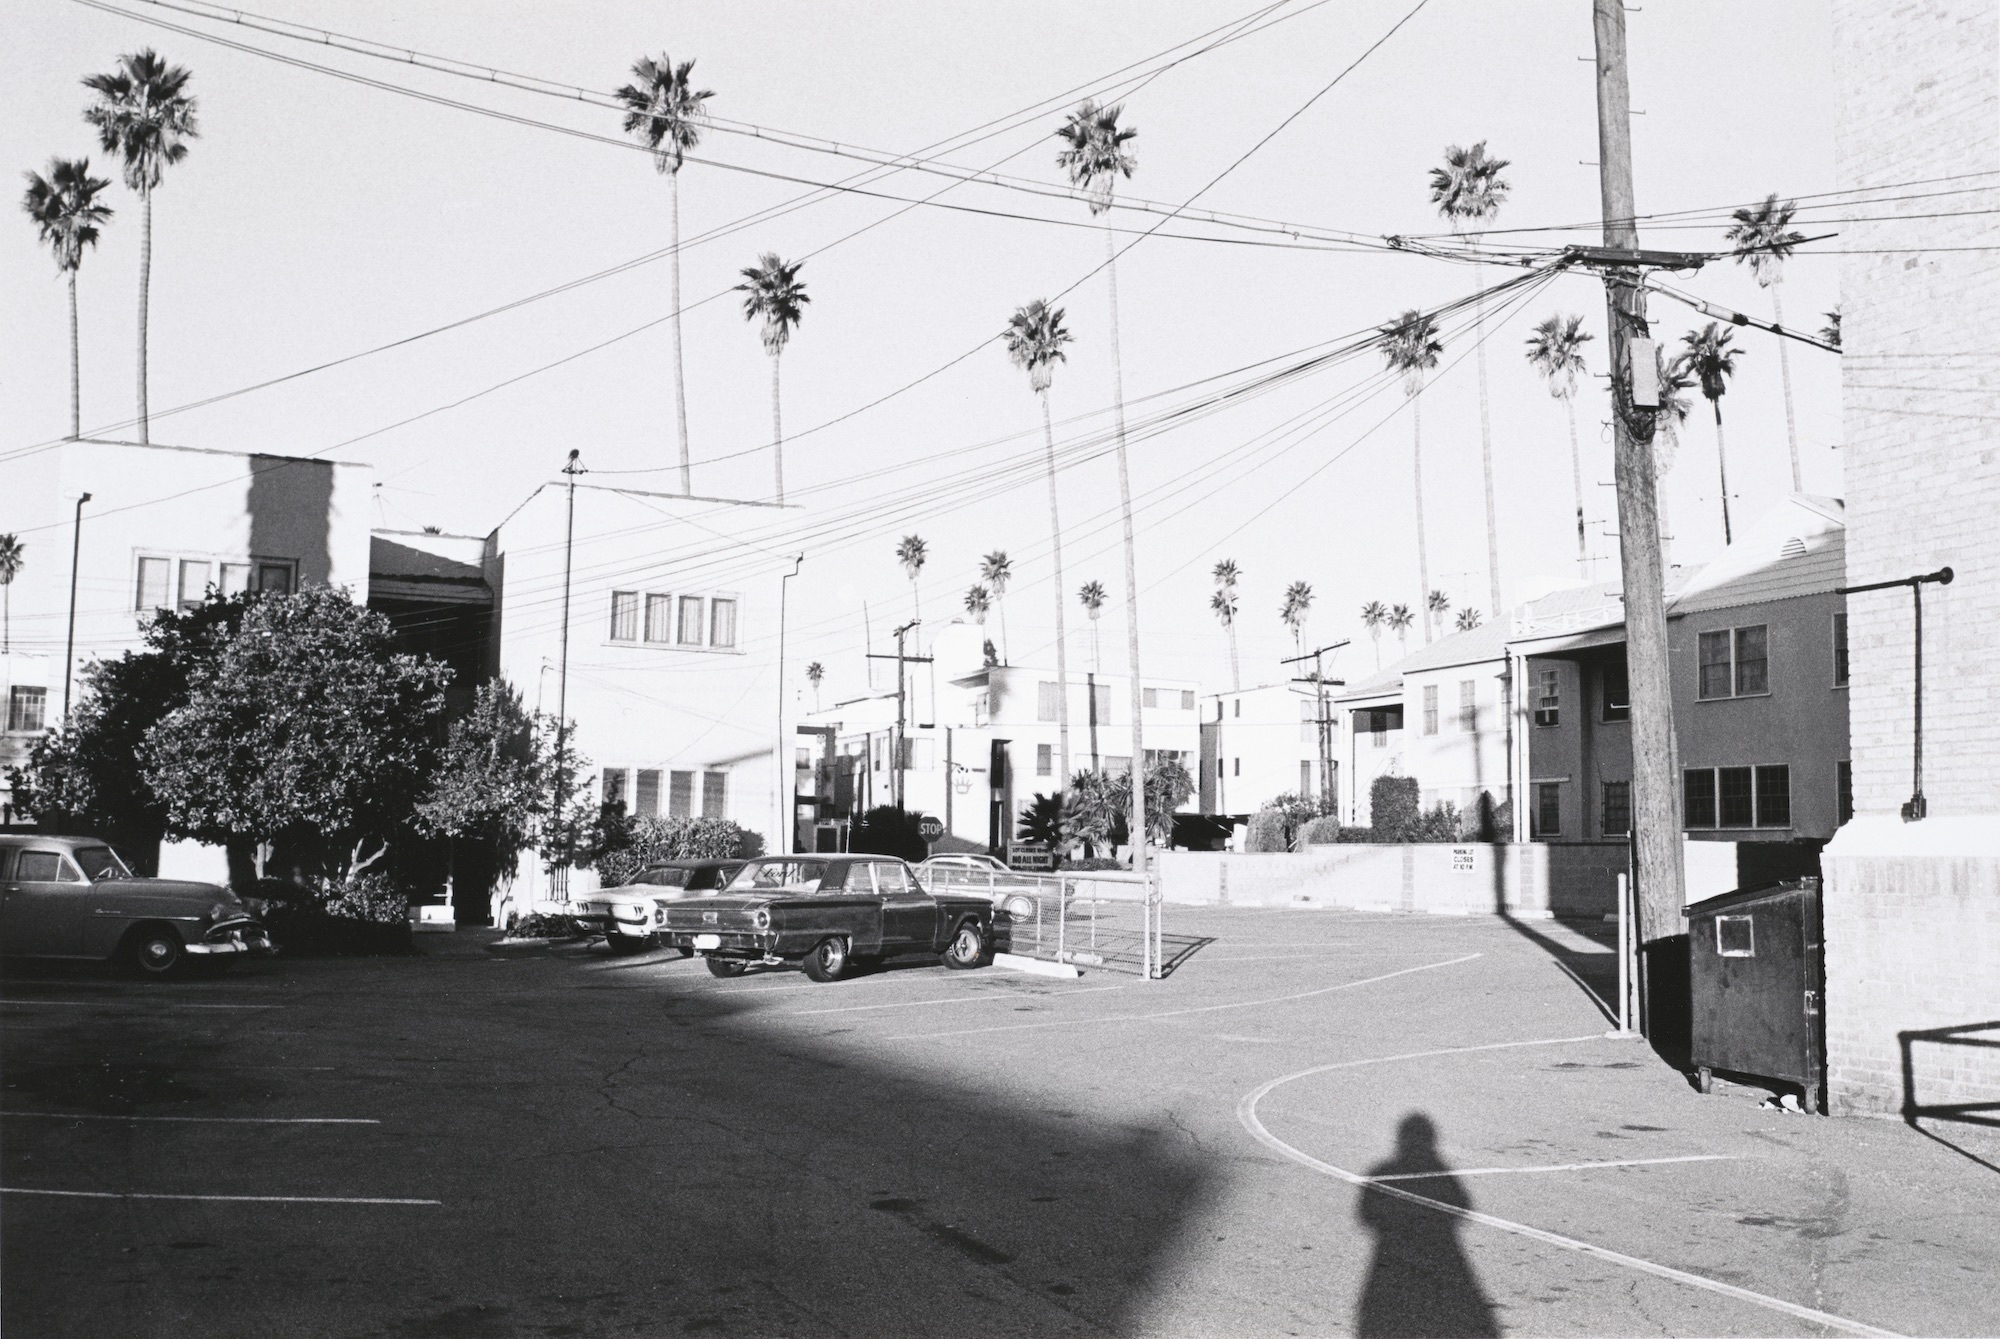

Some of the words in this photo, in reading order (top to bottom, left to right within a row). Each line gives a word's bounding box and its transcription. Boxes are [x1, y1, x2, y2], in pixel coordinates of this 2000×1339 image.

[920, 823, 942, 835] STOP
[1012, 855, 1021, 863] NO
[1022, 855, 1032, 863] ALL
[1033, 855, 1048, 864] NIGHT
